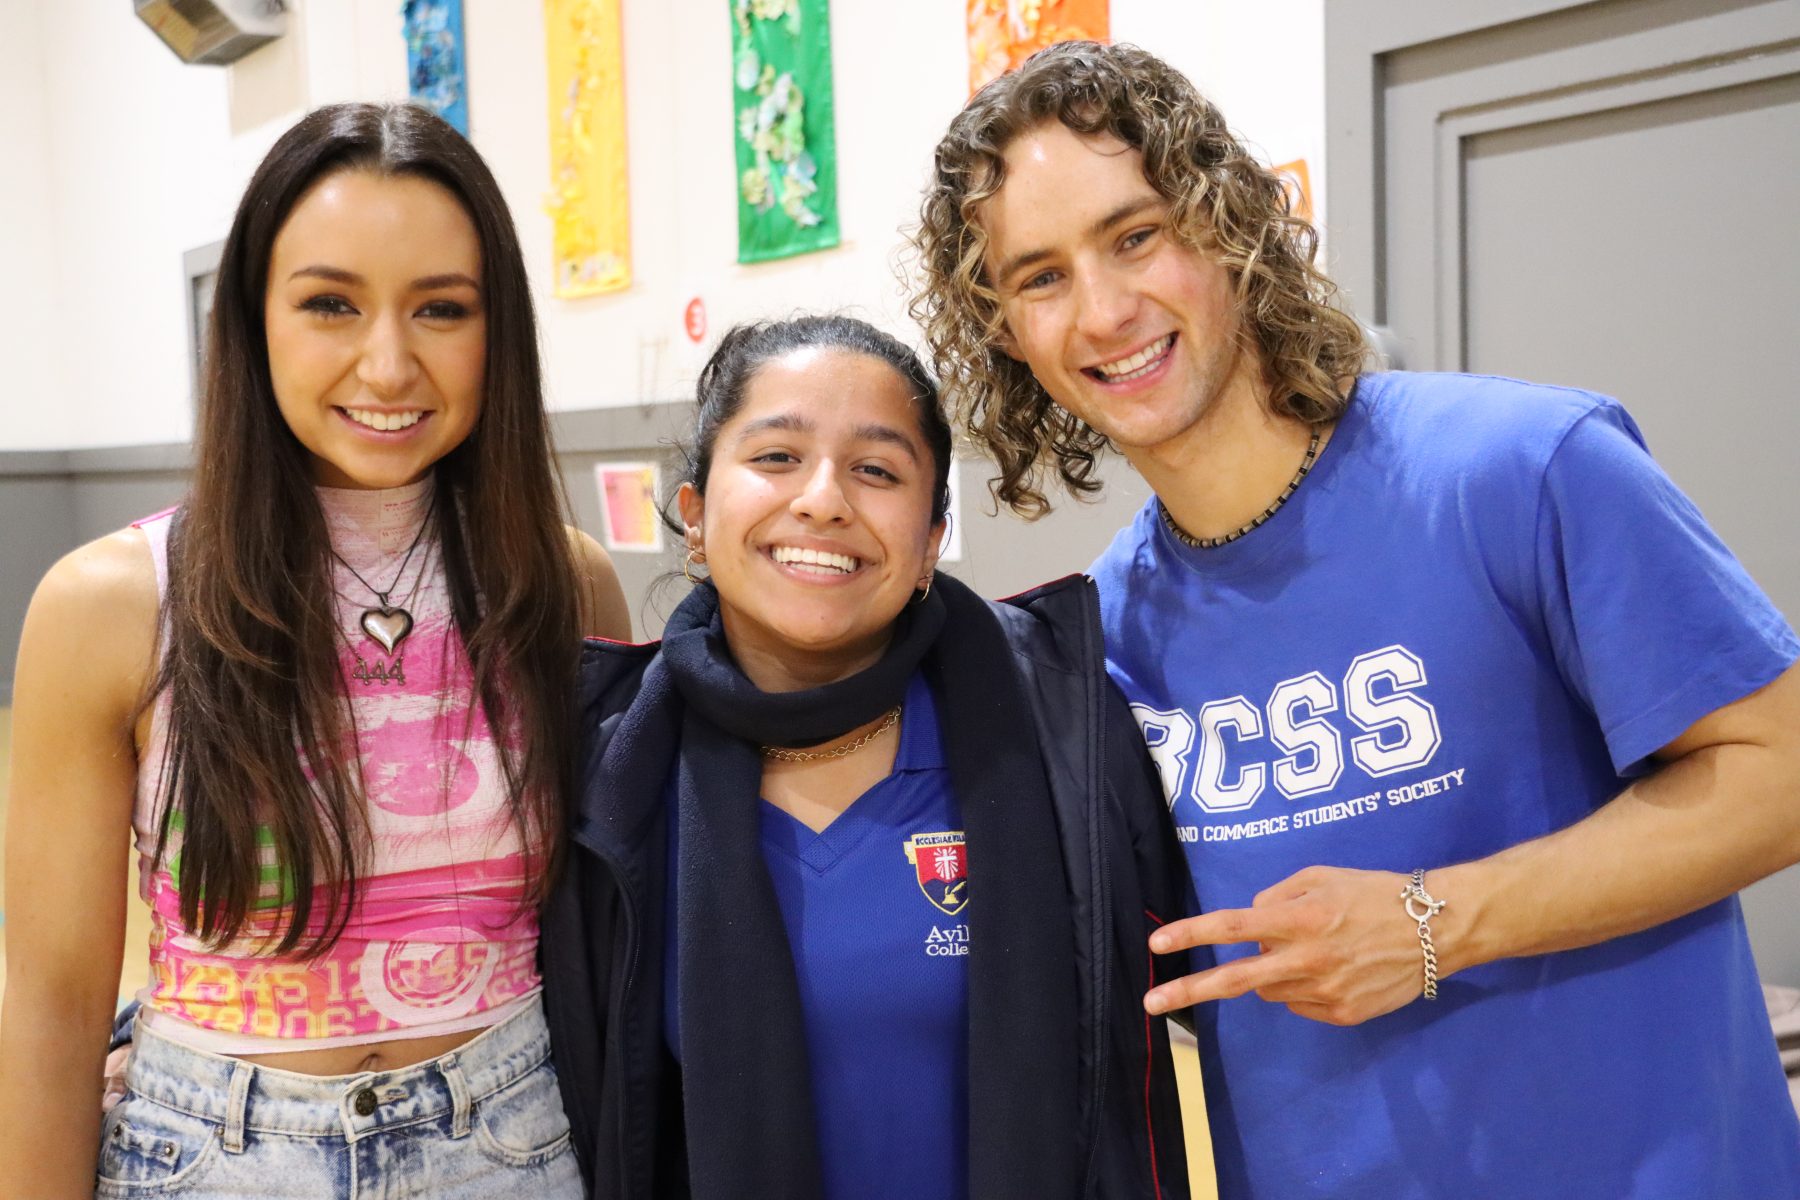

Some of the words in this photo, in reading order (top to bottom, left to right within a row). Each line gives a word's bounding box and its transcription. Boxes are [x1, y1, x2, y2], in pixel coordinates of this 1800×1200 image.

[353, 658, 405, 686] 444
[1203, 816, 1289, 842] COMMERCE
[1293, 791, 1381, 829] STUDENTS'
[1388, 768, 1466, 806] SOCIETY
[926, 942, 969, 956] Colle
